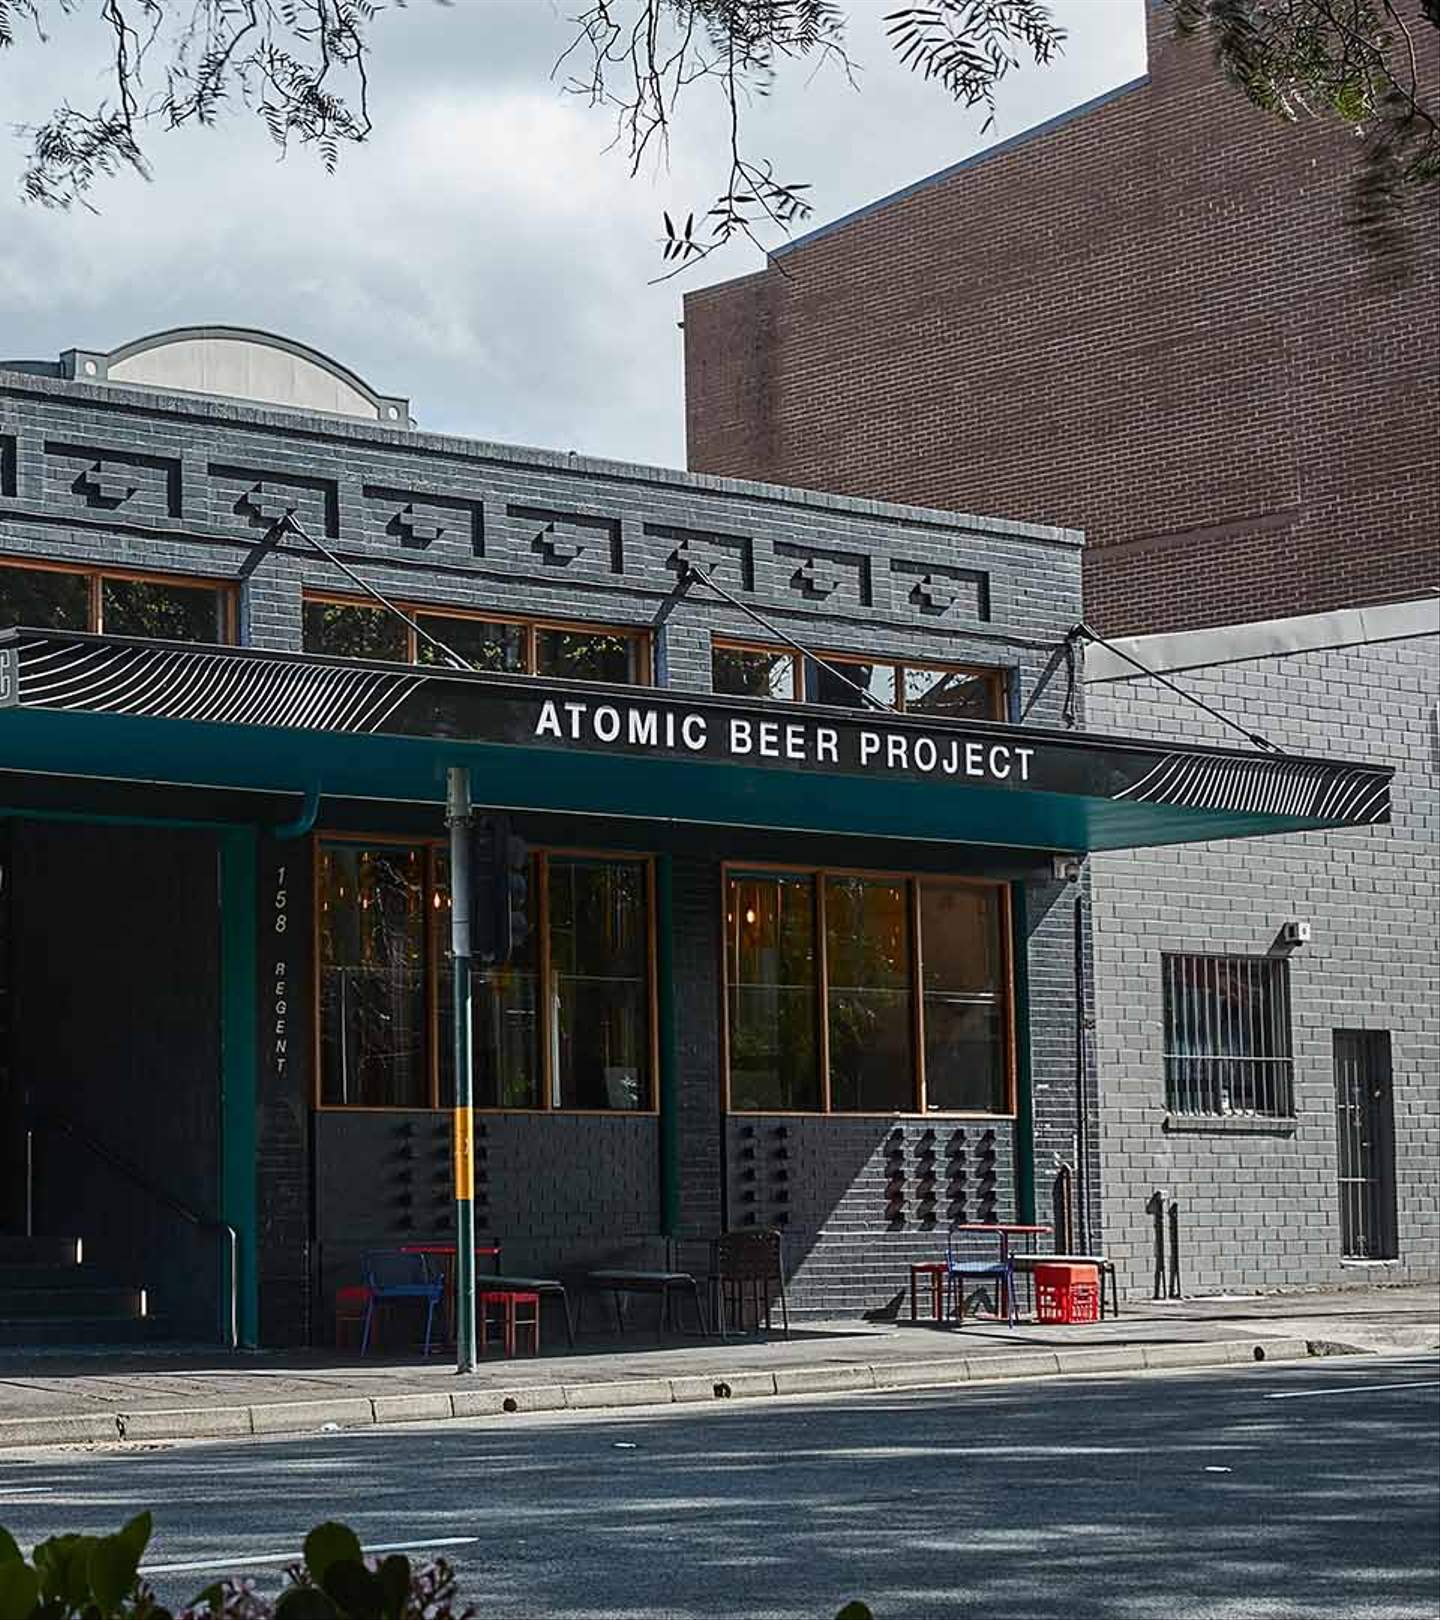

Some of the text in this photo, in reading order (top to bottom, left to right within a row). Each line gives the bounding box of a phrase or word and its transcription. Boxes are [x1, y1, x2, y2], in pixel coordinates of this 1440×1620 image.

[535, 699, 1034, 781] ATOMIC BEER PROJECT
[275, 866, 287, 1073] 158 REGENT
